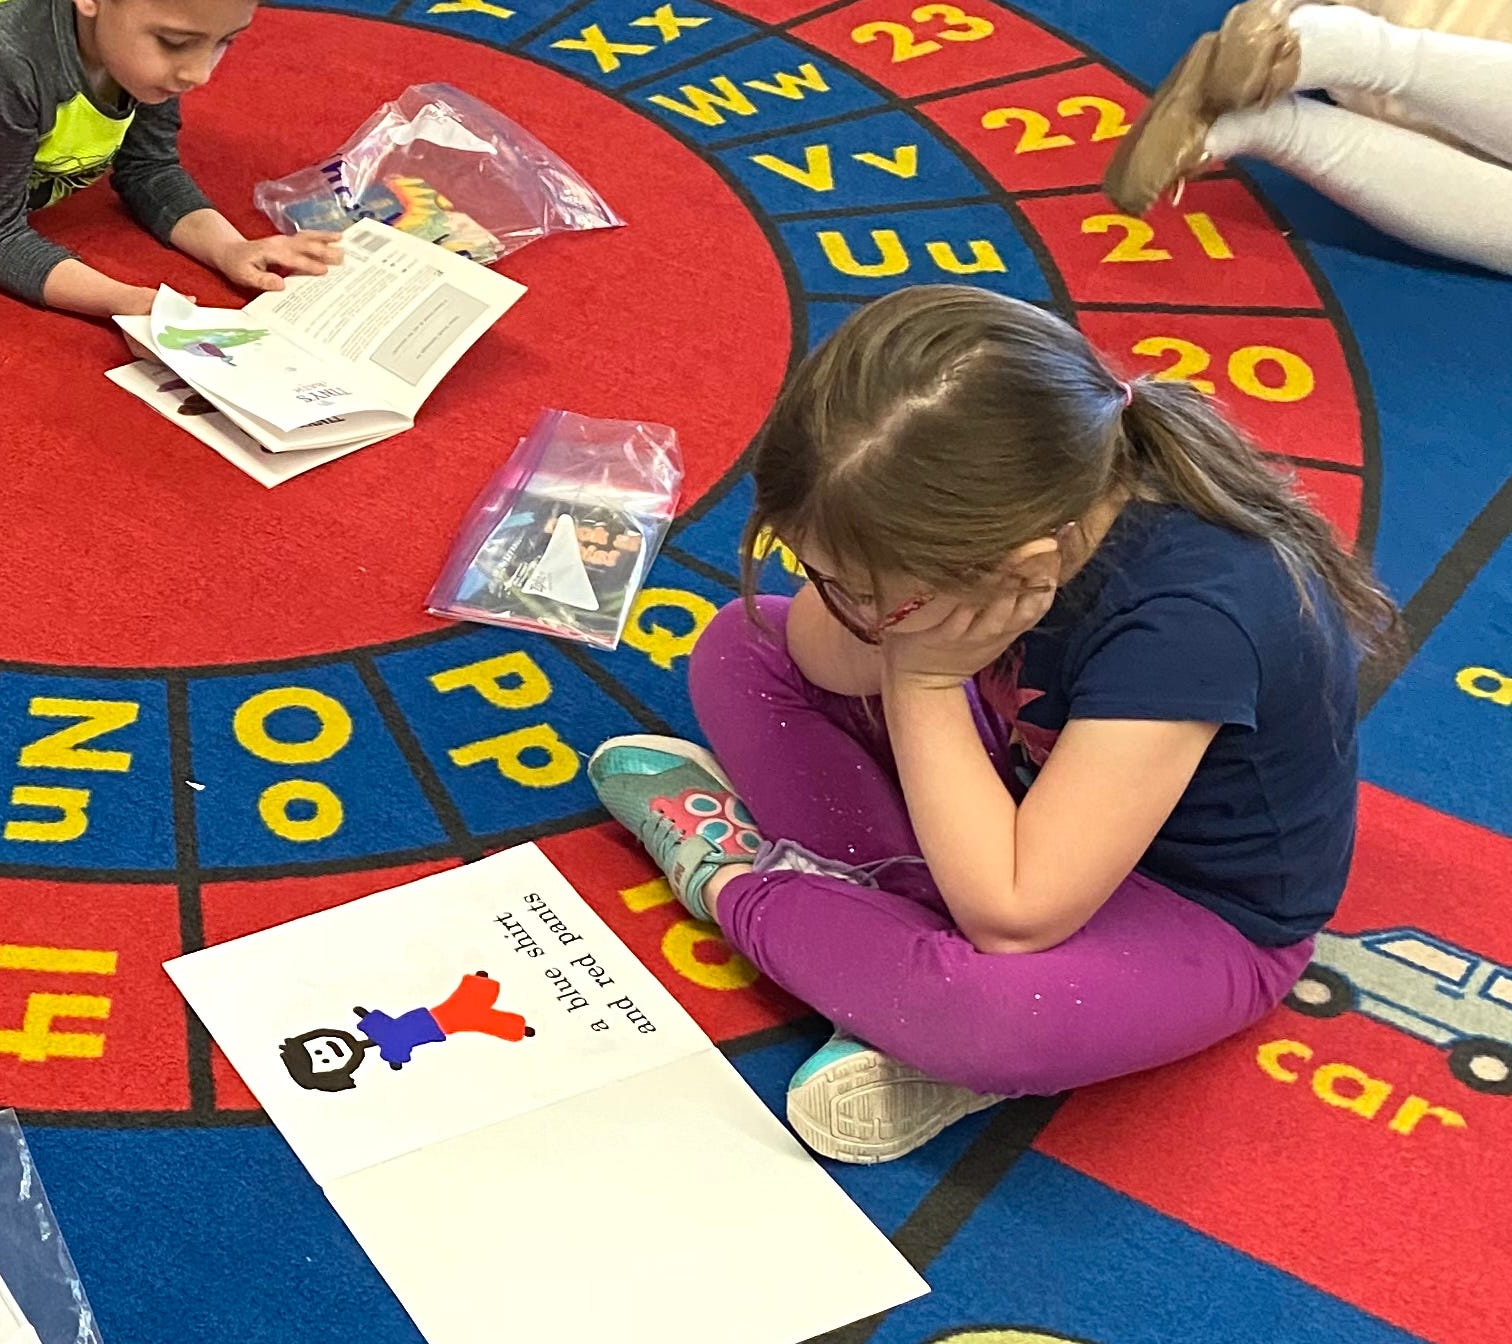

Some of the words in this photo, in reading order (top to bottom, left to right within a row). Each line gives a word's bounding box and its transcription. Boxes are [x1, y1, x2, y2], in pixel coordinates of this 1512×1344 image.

[551, 3, 712, 73] Xx
[850, 2, 995, 63] 23
[648, 62, 830, 126] Ww
[981, 95, 1133, 154] 22
[752, 143, 919, 192] Vv
[816, 228, 1008, 278] Uu
[1080, 212, 1234, 263] 21
[1131, 336, 1316, 404] 20
[429, 650, 582, 789] Pp
[3, 697, 140, 843] Nn
[233, 686, 354, 843] Oo
[492, 911, 545, 958] shirt
[523, 891, 585, 946] pants
[544, 967, 590, 1014] blue
[569, 952, 615, 988] red
[590, 1018, 610, 1032] a
[606, 995, 657, 1035] and
[1255, 1038, 1468, 1136] car
